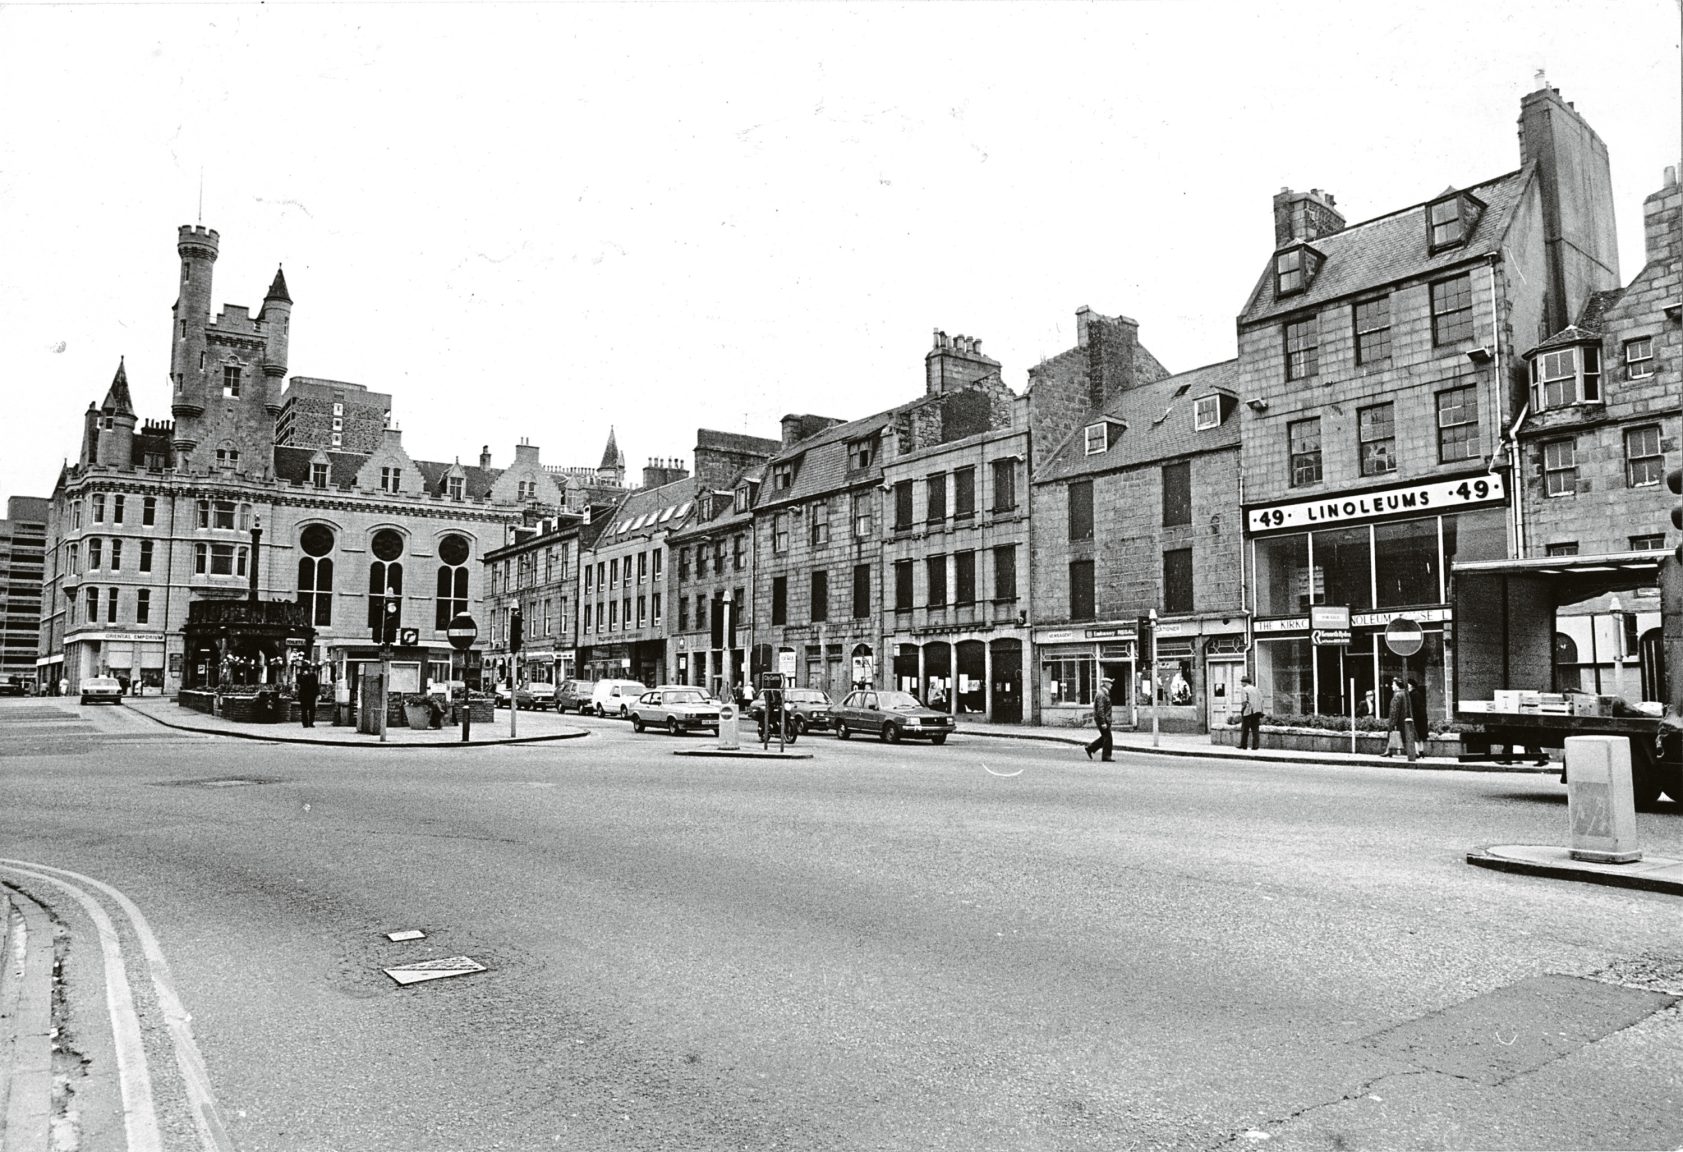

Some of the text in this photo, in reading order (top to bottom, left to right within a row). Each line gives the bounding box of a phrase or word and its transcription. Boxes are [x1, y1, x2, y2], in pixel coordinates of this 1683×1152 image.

[1307, 491, 1430, 521] LINOLEUMS
[1259, 622, 1272, 631] THE
[1280, 619, 1308, 630] KIRKC
[1351, 614, 1391, 627] NOLEUM
